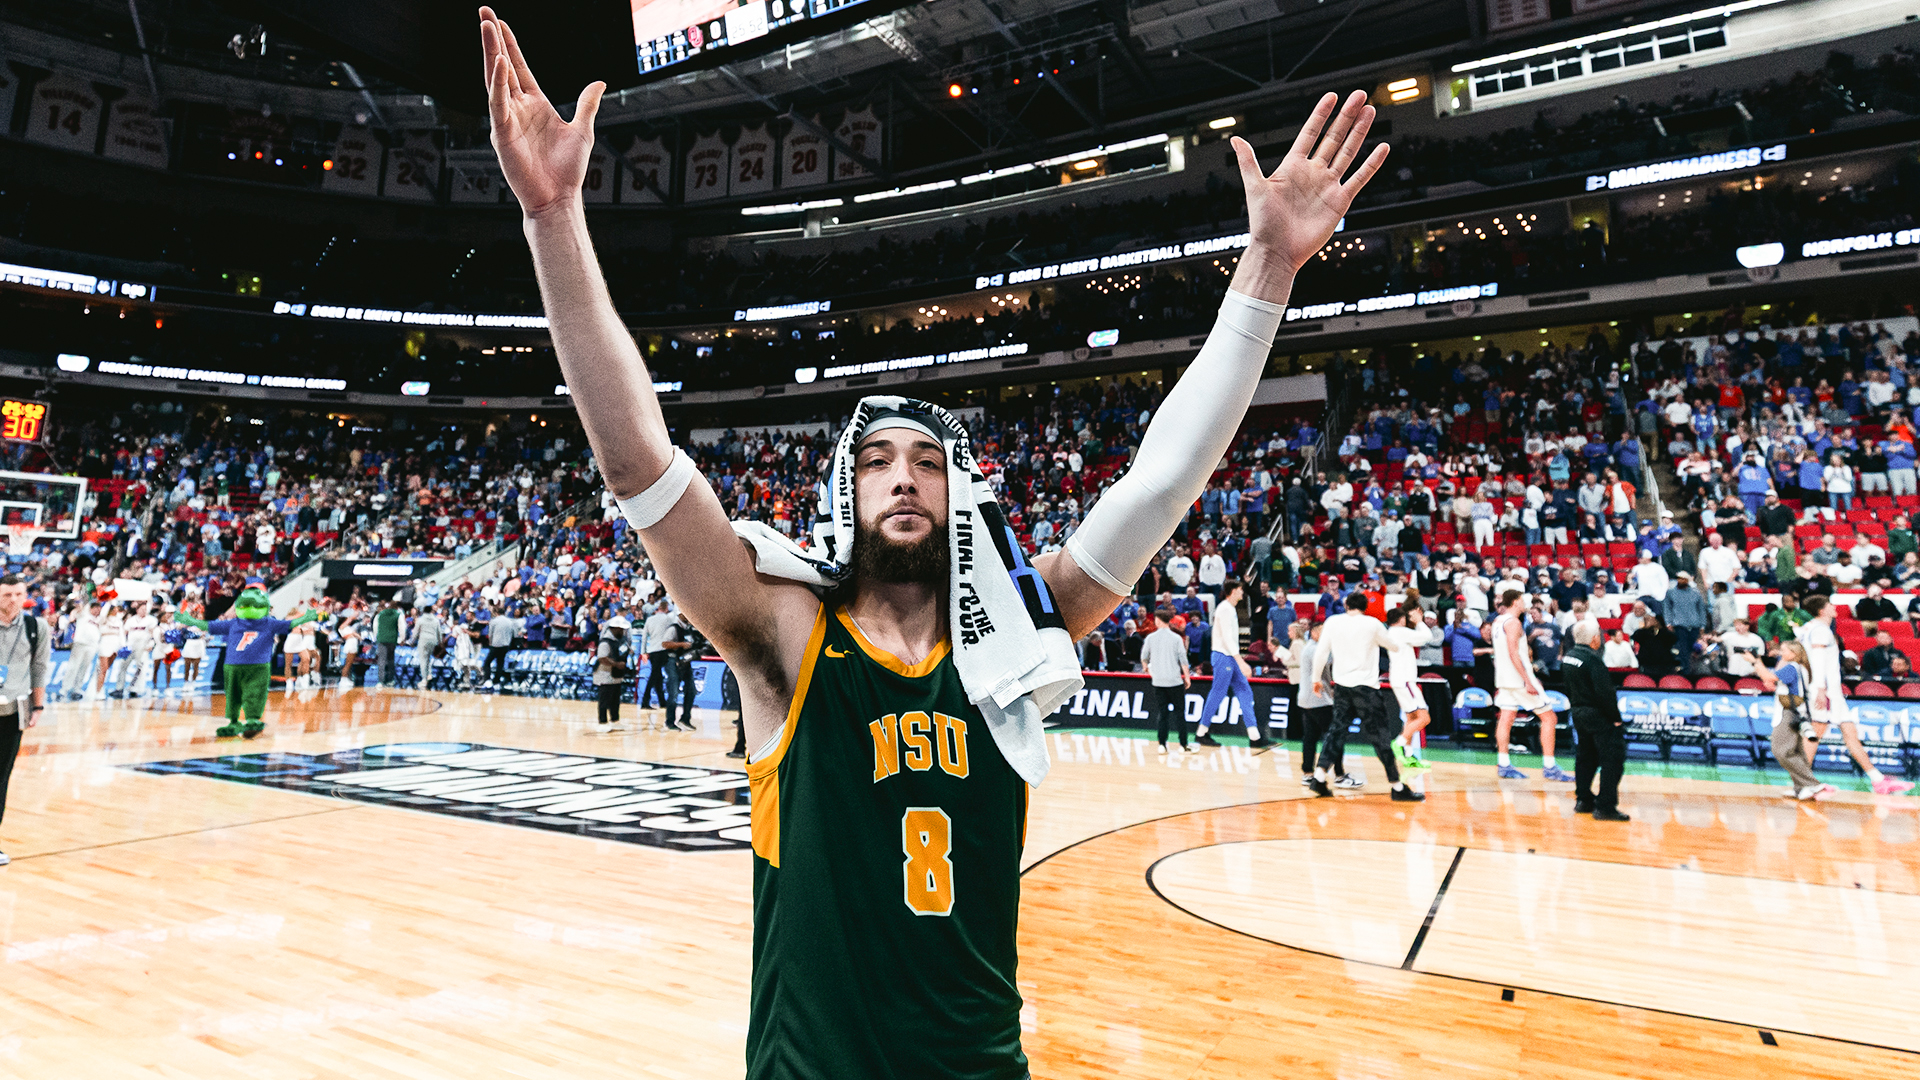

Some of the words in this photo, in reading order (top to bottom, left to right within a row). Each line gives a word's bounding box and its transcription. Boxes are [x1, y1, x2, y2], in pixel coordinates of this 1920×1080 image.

[48, 105, 82, 135] 14
[336, 155, 367, 181] 32
[740, 157, 764, 183] 24
[792, 149, 817, 175] 20
[695, 164, 718, 189] 73
[1802, 232, 1892, 257] NORFOLK
[1009, 268, 1041, 284] 2025
[1060, 258, 1098, 276] MEN'S
[1100, 245, 1182, 270] BASKETBALL
[1184, 233, 1251, 255] CHAMPIO
[1302, 302, 1344, 319] FIRST
[1357, 293, 1416, 312] SECOND
[1417, 285, 1480, 305] ROUNDS
[402, 312, 474, 326] BASKETBALL
[824, 365, 861, 378] NORFOLK
[861, 361, 888, 373] STATE
[888, 355, 934, 370] SPARTANS
[948, 348, 988, 363] FLORIDA
[989, 343, 1028, 357] GATORS
[3, 415, 39, 440] 30
[972, 607, 996, 638] THE
[236, 631, 258, 652] F
[868, 711, 970, 784] NSU
[901, 806, 955, 917] 8
